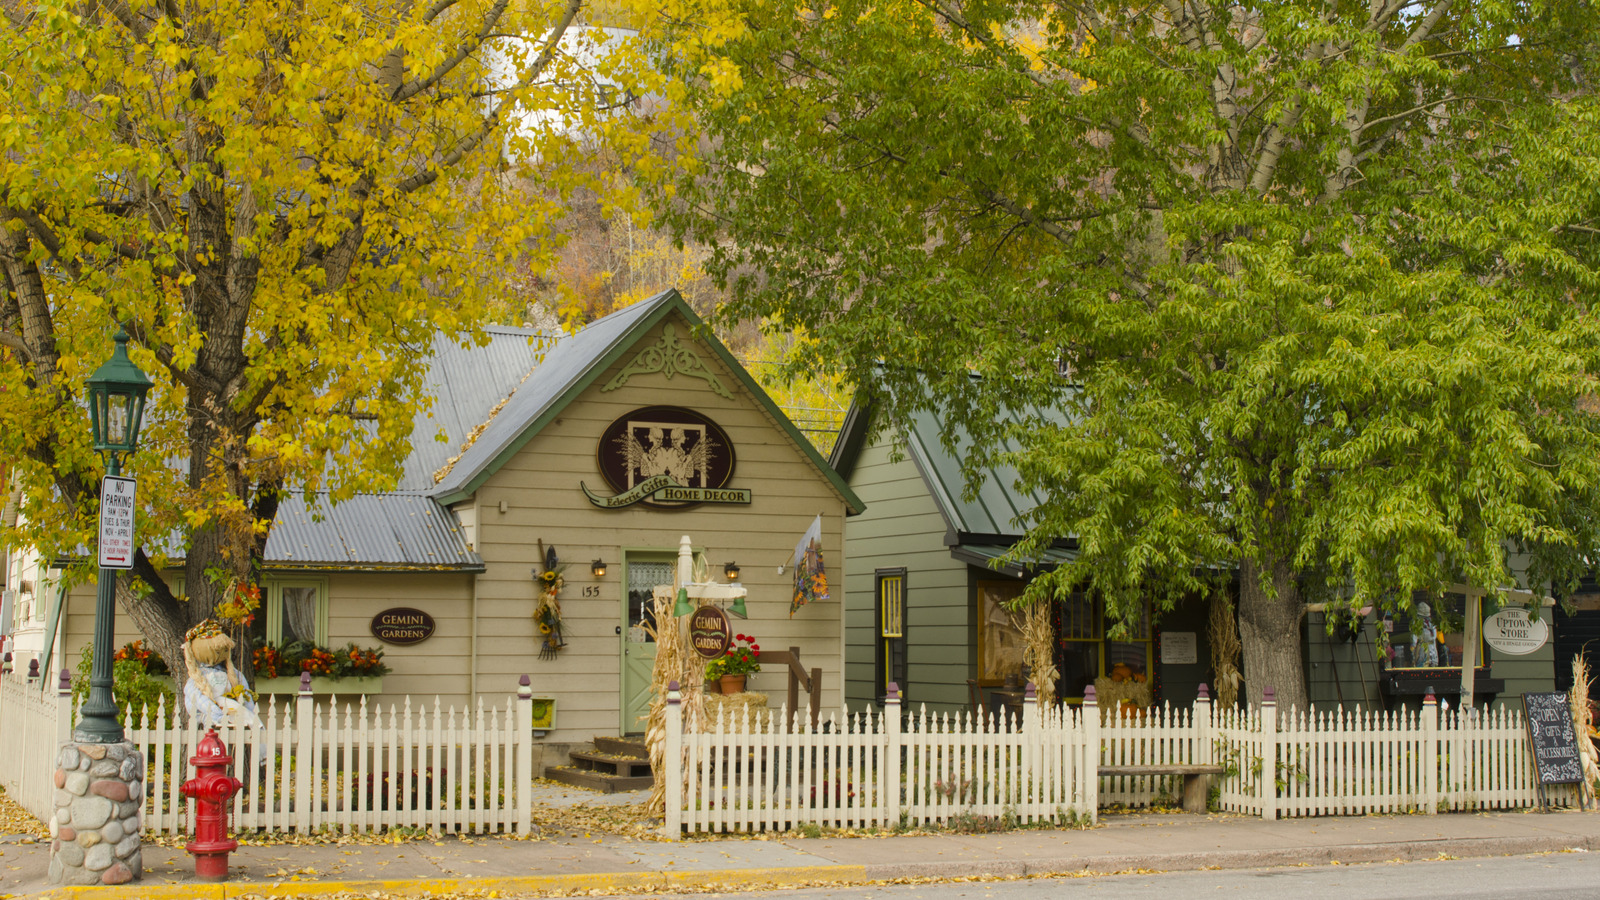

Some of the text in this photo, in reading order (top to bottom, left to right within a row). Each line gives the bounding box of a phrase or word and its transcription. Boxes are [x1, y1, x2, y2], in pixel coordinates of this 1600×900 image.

[115, 481, 124, 494] NO
[606, 476, 669, 507] Eclectic Gifts
[105, 494, 132, 508] PARKING
[664, 489, 745, 501] HOME DECOR
[104, 517, 114, 526] TUES
[105, 528, 114, 536] NOV
[582, 585, 600, 598] 155
[381, 615, 424, 625] GEMINI
[695, 616, 722, 630] GEMINI
[1496, 617, 1533, 628] UPTOWN
[381, 630, 425, 638] GARDENS
[1500, 628, 1529, 638] STORE
[695, 637, 722, 650] GARDENS
[1540, 708, 1561, 722] OPEN
[1545, 725, 1561, 737] GIFTS
[1553, 737, 1558, 747] &
[212, 747, 221, 756] 15
[1539, 746, 1575, 759] ACCESSORIES
